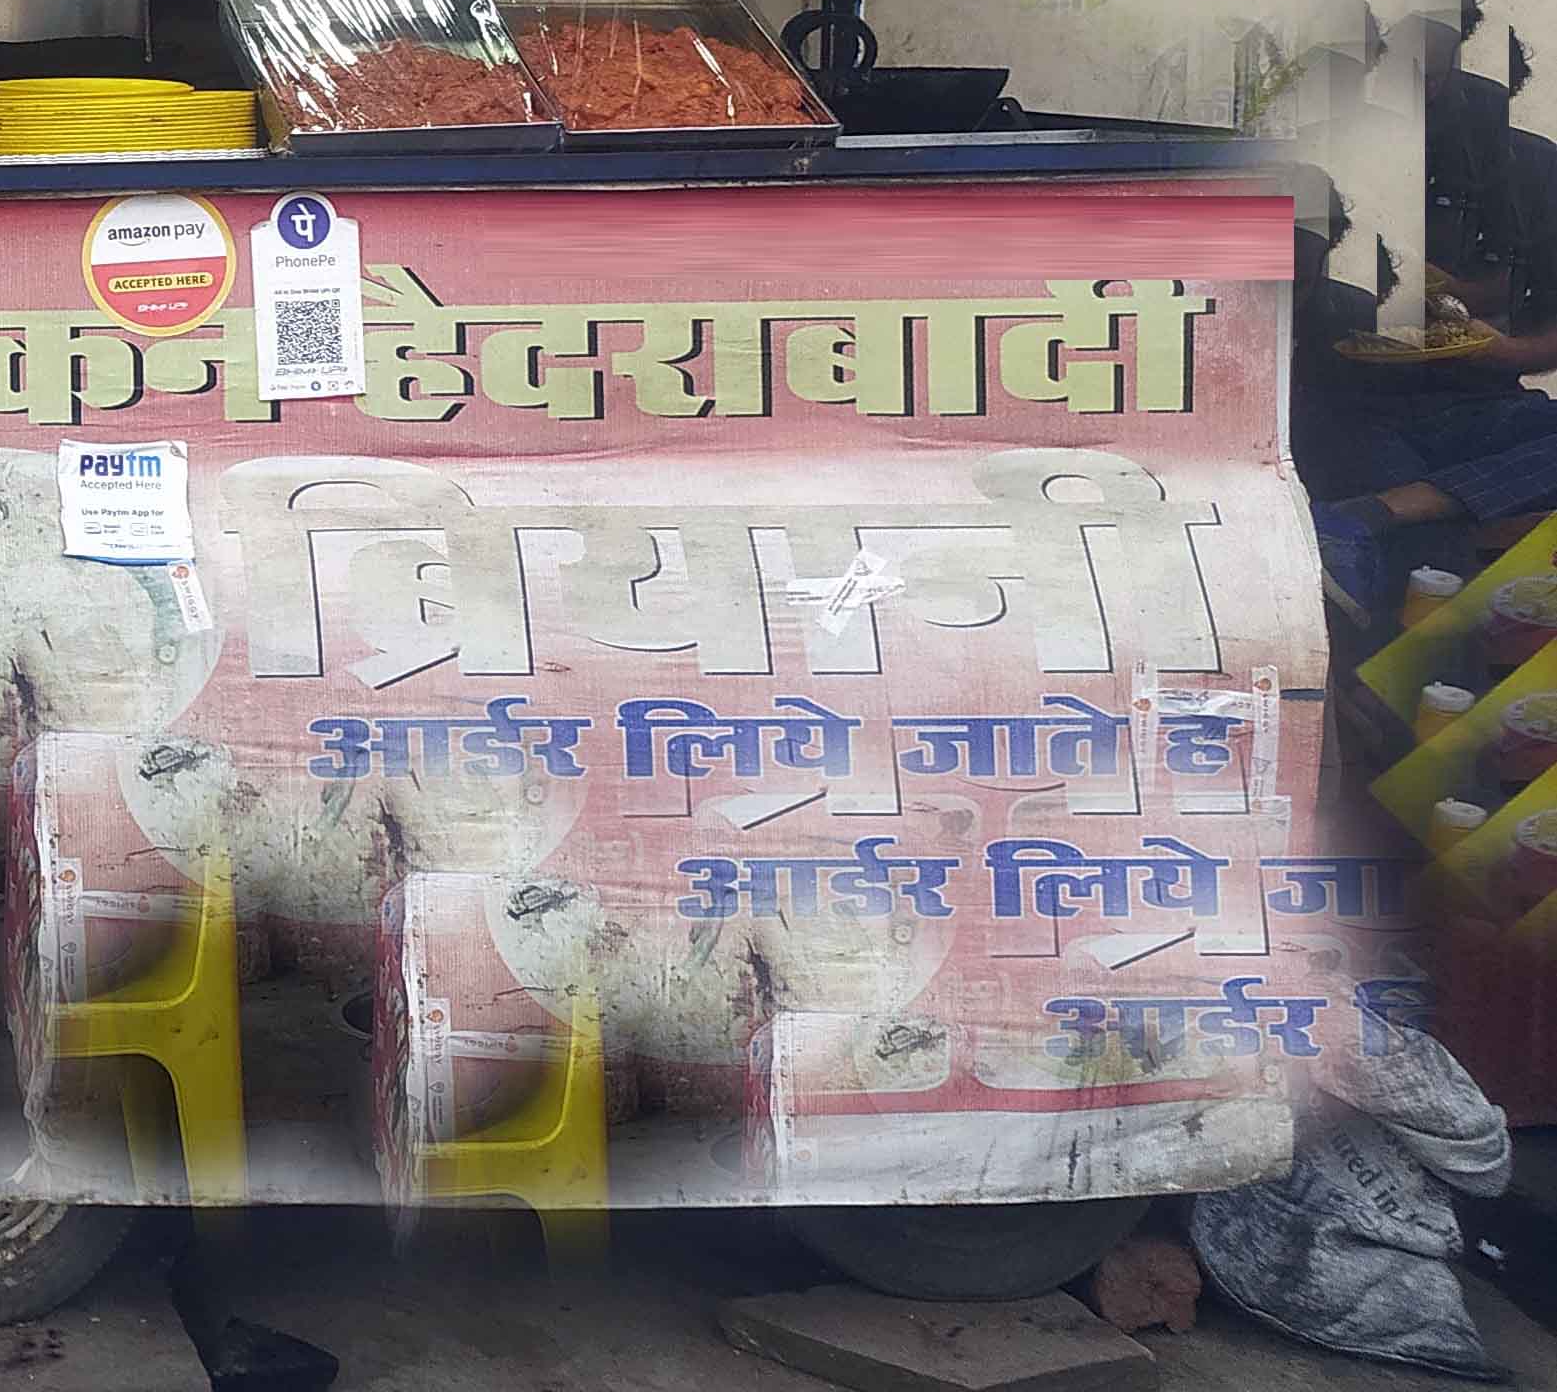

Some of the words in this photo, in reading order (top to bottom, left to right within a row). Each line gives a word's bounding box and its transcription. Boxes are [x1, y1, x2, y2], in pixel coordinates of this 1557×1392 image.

[107, 224, 171, 241] amazon
[174, 222, 206, 240] pay
[114, 276, 173, 290] ACCEPTED
[176, 274, 207, 286] HERE
[275, 254, 336, 268] PhonePe
[353, 264, 1217, 420] हैदराबादी
[80, 479, 133, 491] Accepted
[135, 480, 162, 490] Here
[100, 509, 130, 517] Paytm
[131, 509, 150, 517] App
[219, 447, 1222, 691] ब्रियानी
[308, 696, 592, 778] आर्डर
[615, 696, 863, 778] लिये
[891, 693, 1131, 777] जाते
[675, 835, 962, 921] आर्डर
[984, 836, 1231, 920] लिये
[1043, 977, 1328, 1059] आर्डर
